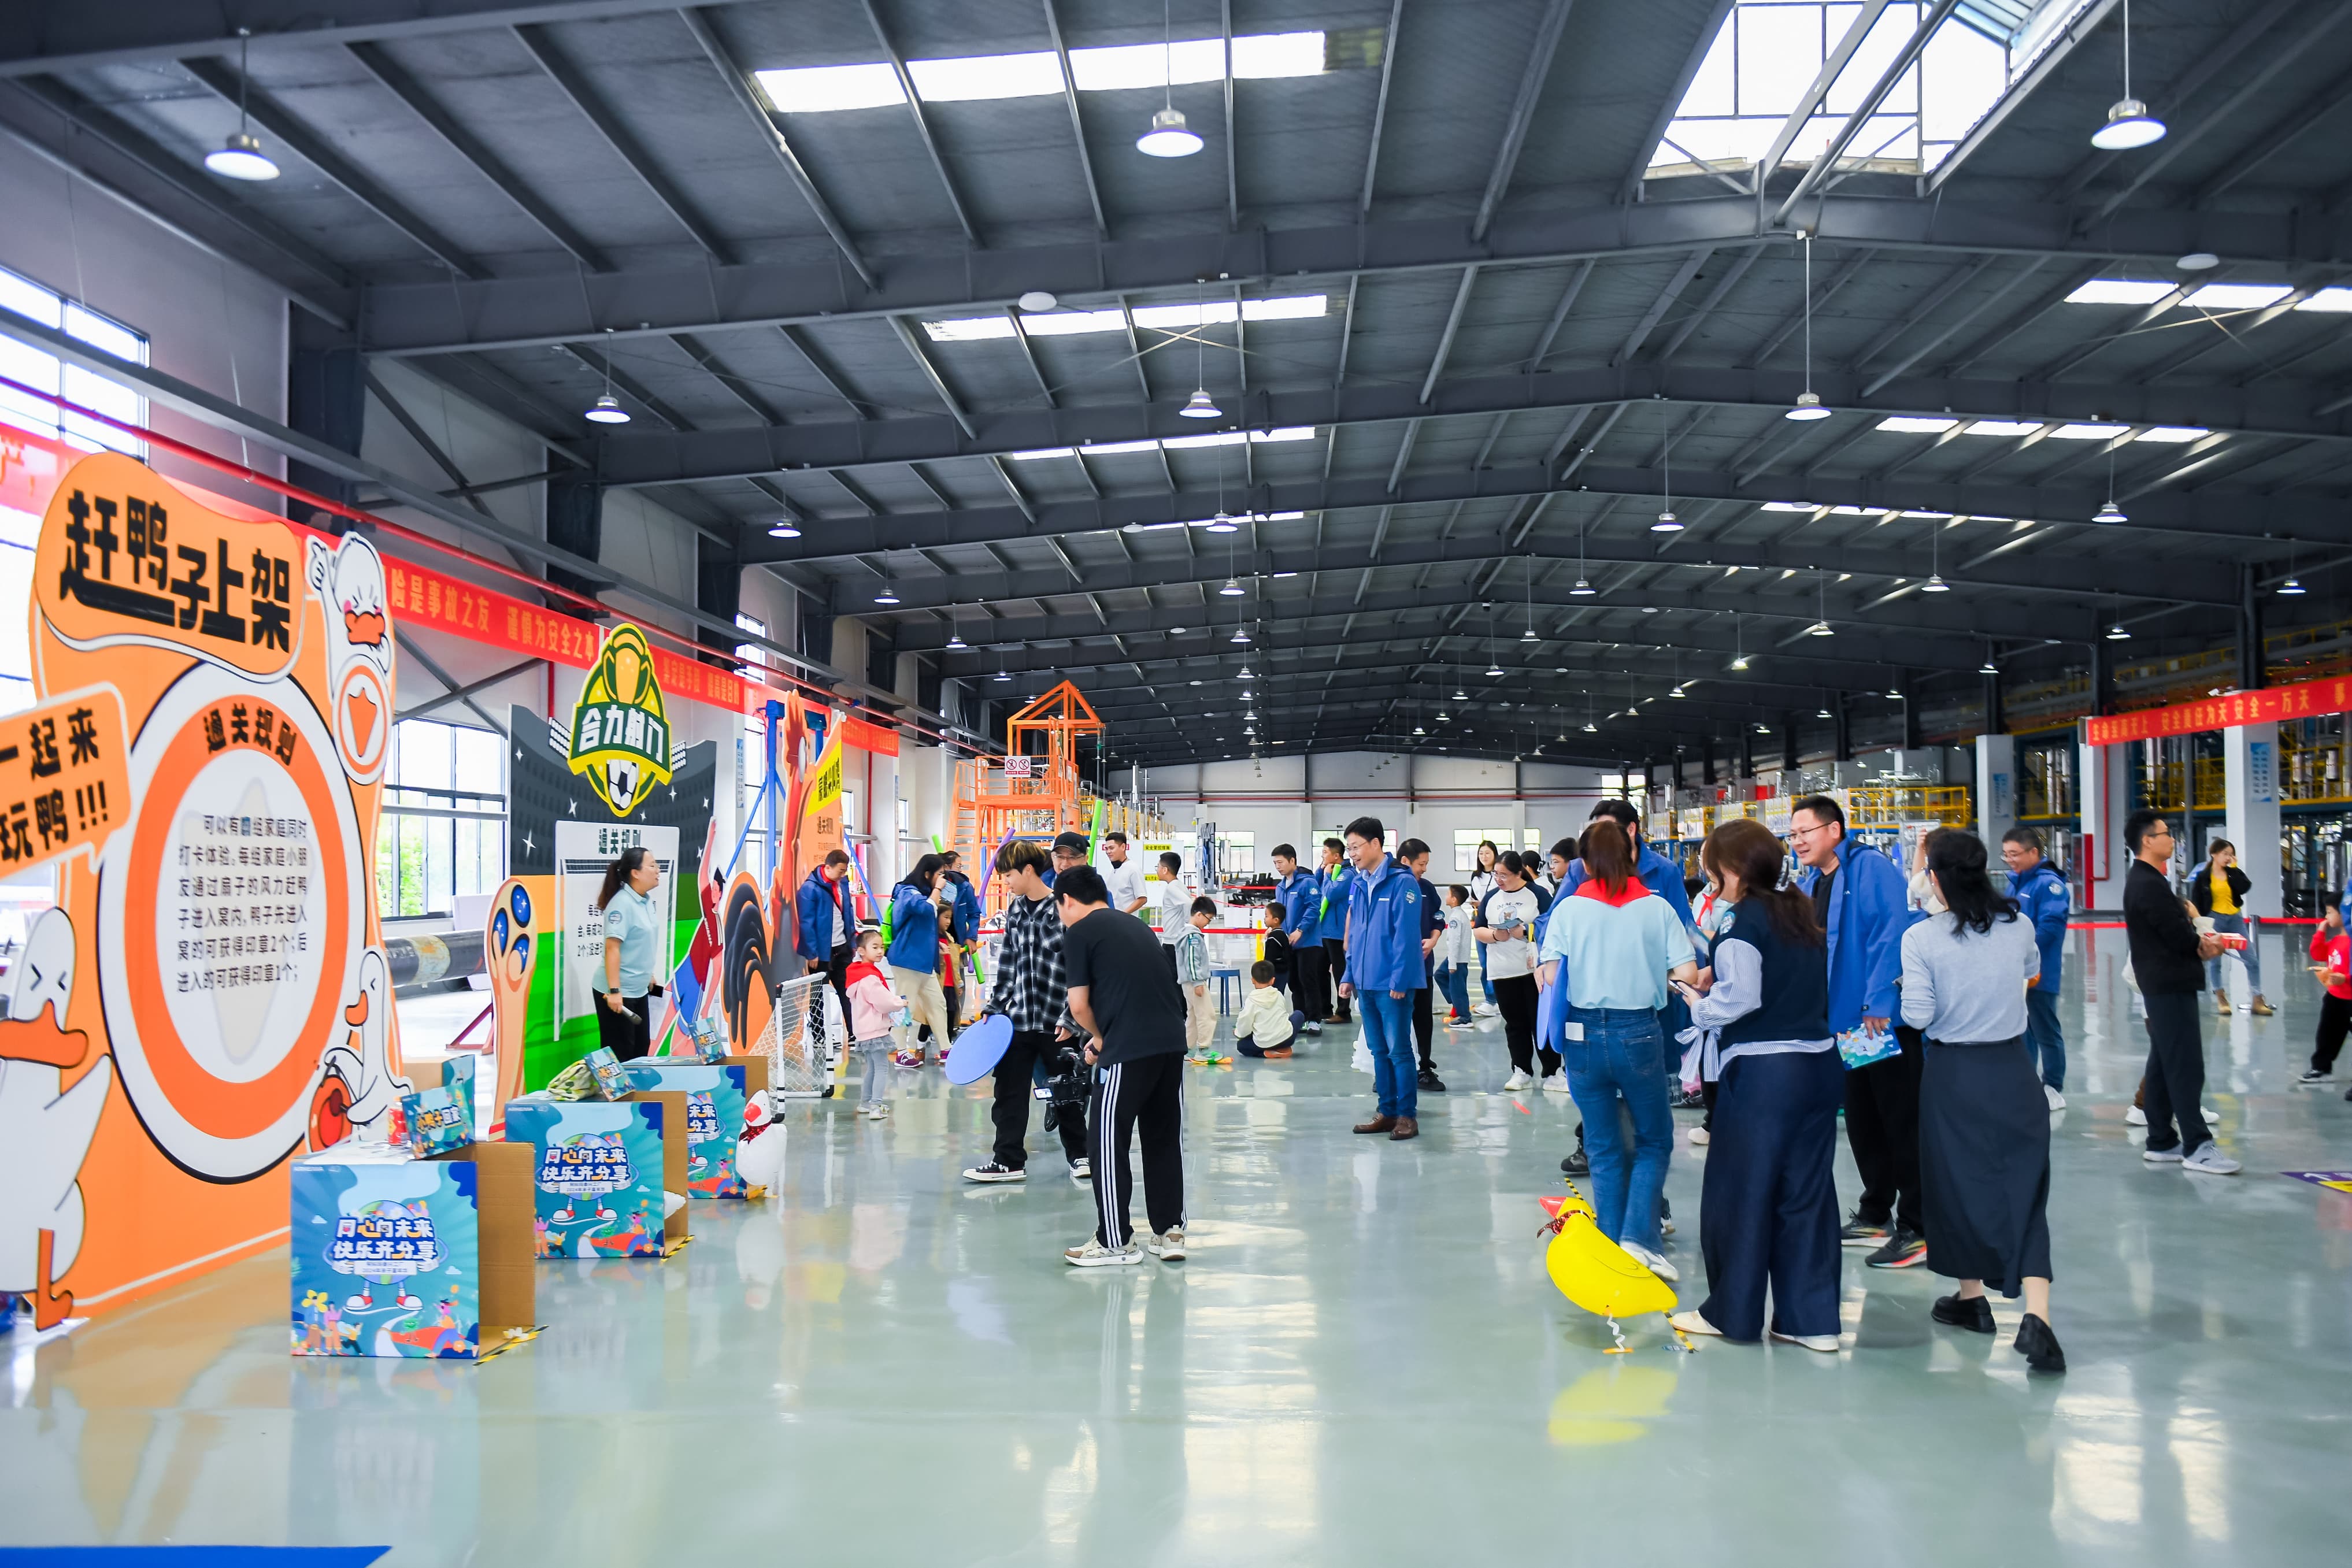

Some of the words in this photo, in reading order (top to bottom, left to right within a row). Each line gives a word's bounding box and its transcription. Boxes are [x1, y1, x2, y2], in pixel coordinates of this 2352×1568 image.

[60, 488, 290, 654] 赶鸭子上架
[391, 568, 490, 633] 险是事故之友
[507, 605, 594, 662] 谨慎为安全之本
[2234, 688, 2310, 721] 安全一万天
[203, 703, 297, 766] 通关规则
[579, 704, 664, 763] 合力射门
[2092, 715, 2149, 742] 生命至高无上
[2161, 703, 2227, 731] 安全责任为天
[0, 707, 99, 781] 一起来
[204, 815, 307, 837] 可以有组家庭同时
[688, 1104, 716, 1118] 未来
[687, 1120, 718, 1133] 分享
[545, 1148, 627, 1164] 同心向未来
[542, 1165, 629, 1181] 快乐齐分享
[336, 1219, 434, 1239] 同心向未来
[333, 1241, 438, 1260] 快乐齐分享
